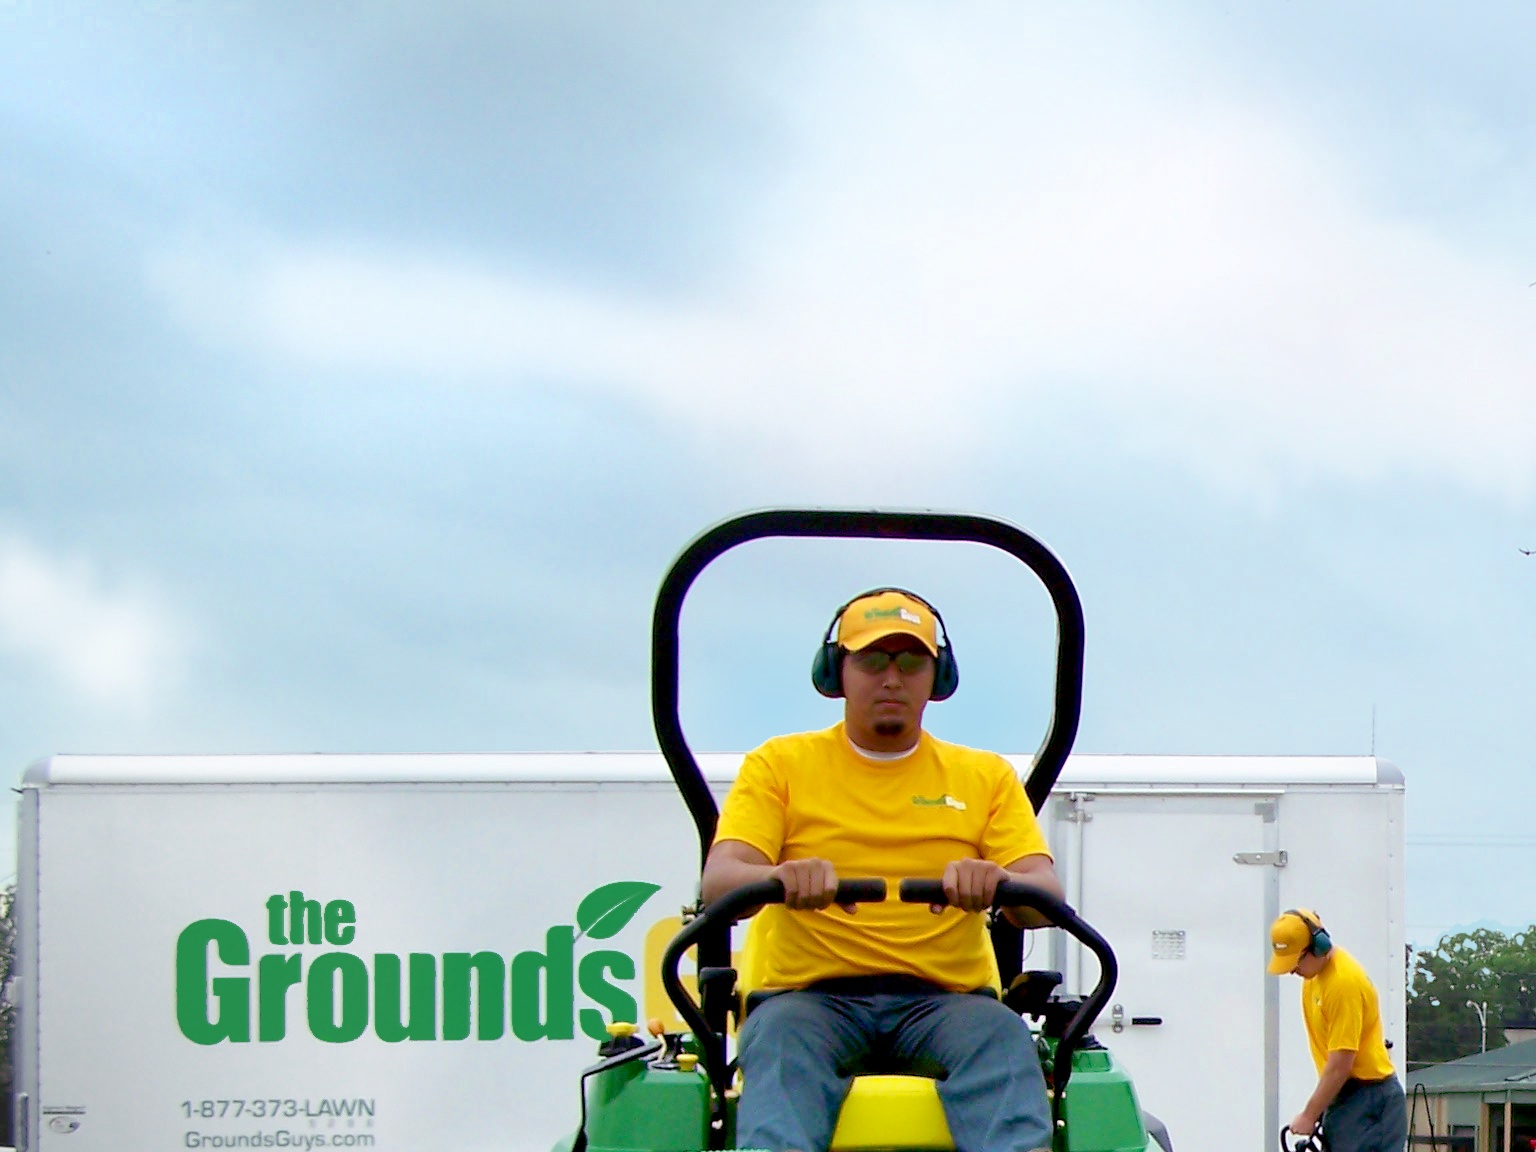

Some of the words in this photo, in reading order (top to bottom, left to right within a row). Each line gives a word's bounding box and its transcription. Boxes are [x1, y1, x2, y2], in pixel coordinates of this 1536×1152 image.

[266, 890, 356, 945] the
[176, 918, 638, 1045] Grounds
[181, 1099, 376, 1118] 1-877-373-LAWN
[185, 1129, 375, 1151] GroundsGuys.com
